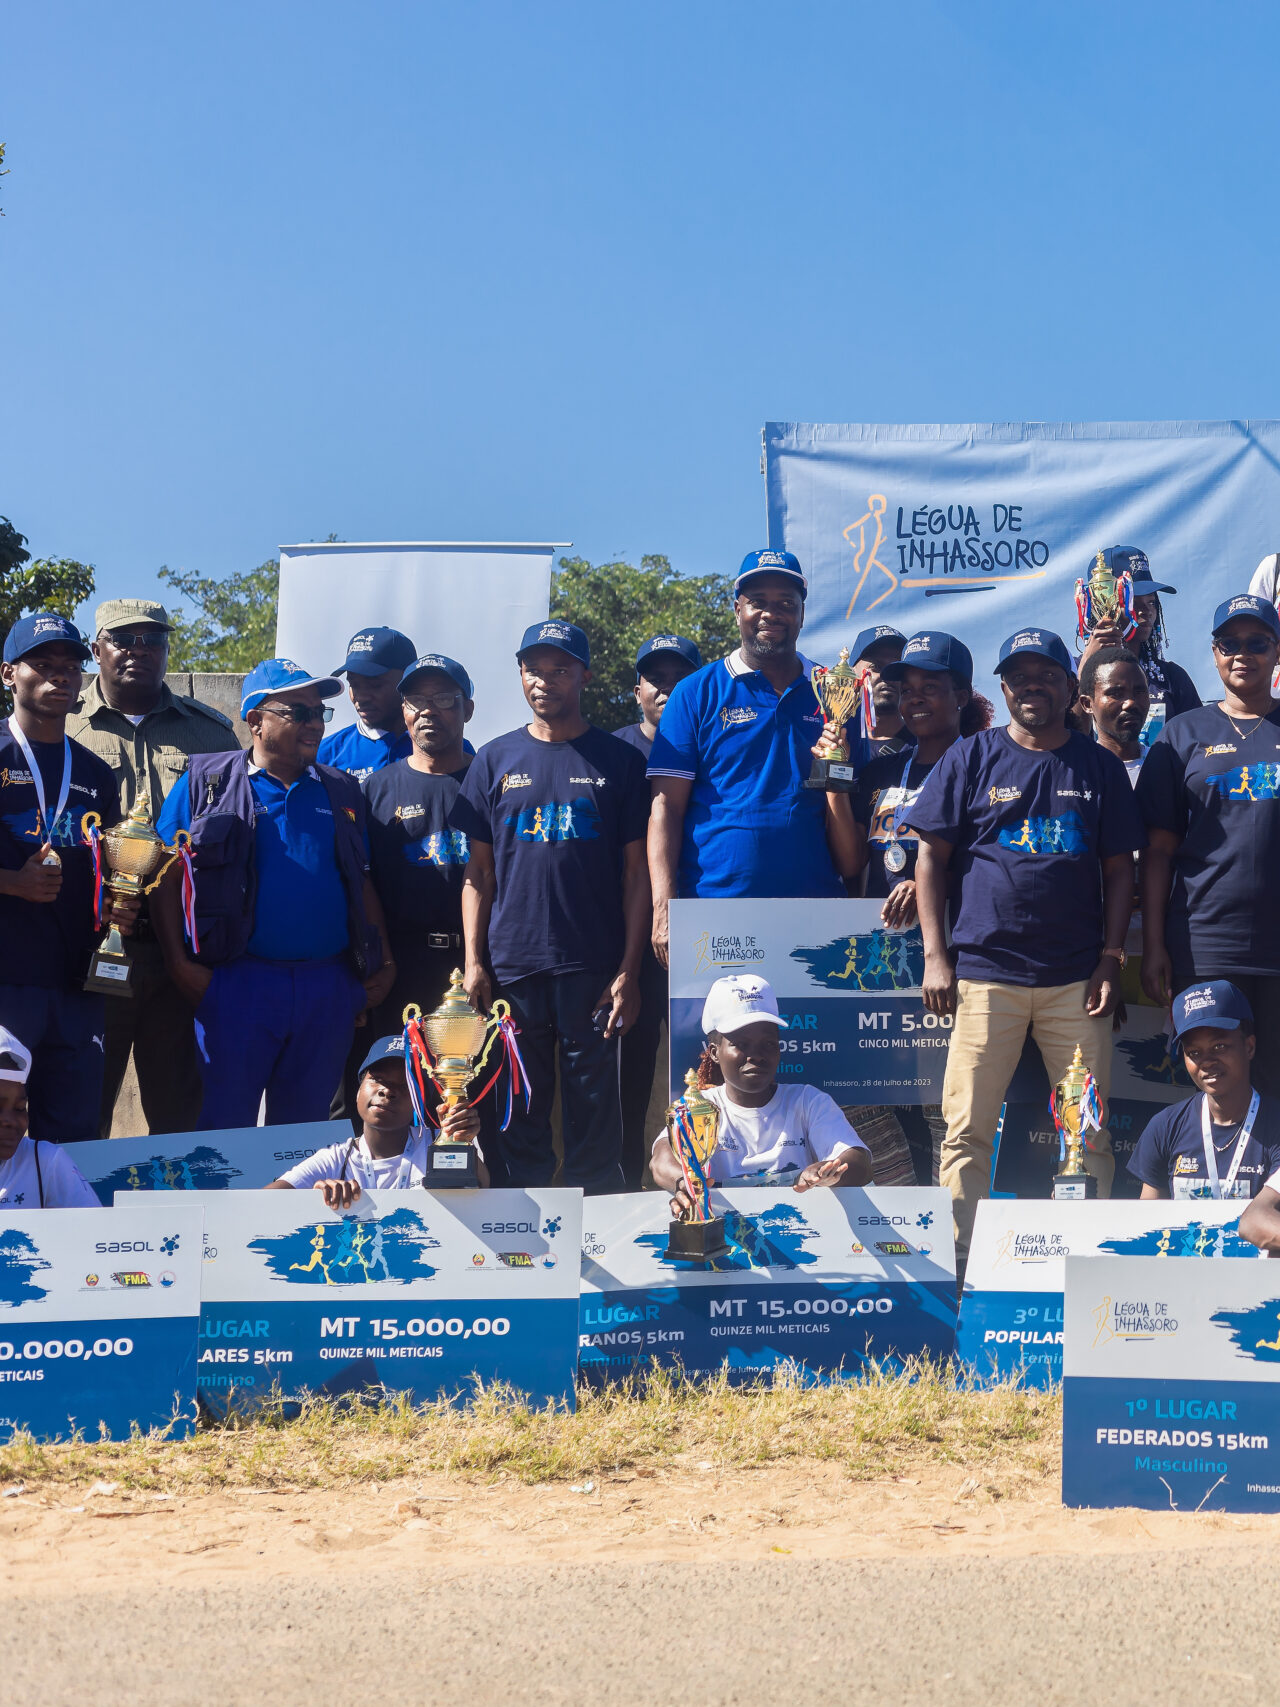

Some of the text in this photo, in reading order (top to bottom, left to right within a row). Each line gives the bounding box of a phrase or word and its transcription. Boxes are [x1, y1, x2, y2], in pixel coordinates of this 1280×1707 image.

[897, 505, 1021, 539] LÉGUA DE
[897, 537, 1049, 574] INHASSORO
[712, 935, 756, 948] LÉGUA DE
[712, 948, 765, 960] INHASSORO
[859, 1012, 892, 1029] MT
[802, 1040, 836, 1054] 5km
[859, 1039, 909, 1048] CINCO MIL
[1015, 1233, 1062, 1245] LÉGUA DE
[1014, 1244, 1070, 1256] INHASSORO
[585, 1303, 660, 1325] LUGAR
[710, 1297, 893, 1318] MT 15.000,00
[1115, 1301, 1168, 1316] LÉGUA DE
[320, 1316, 510, 1340] MT 15.000,00
[710, 1323, 830, 1337] QUINZE MIL METICAIS
[1115, 1317, 1178, 1332] INHASSORO
[647, 1328, 684, 1344] 5km
[254, 1348, 293, 1364] 5km
[319, 1347, 443, 1360] QUINZE MIL METICAIS
[1156, 1399, 1237, 1421] LUGAR
[1097, 1428, 1268, 1450] FEDERADOS 15km
[1135, 1456, 1228, 1474] Masculino
